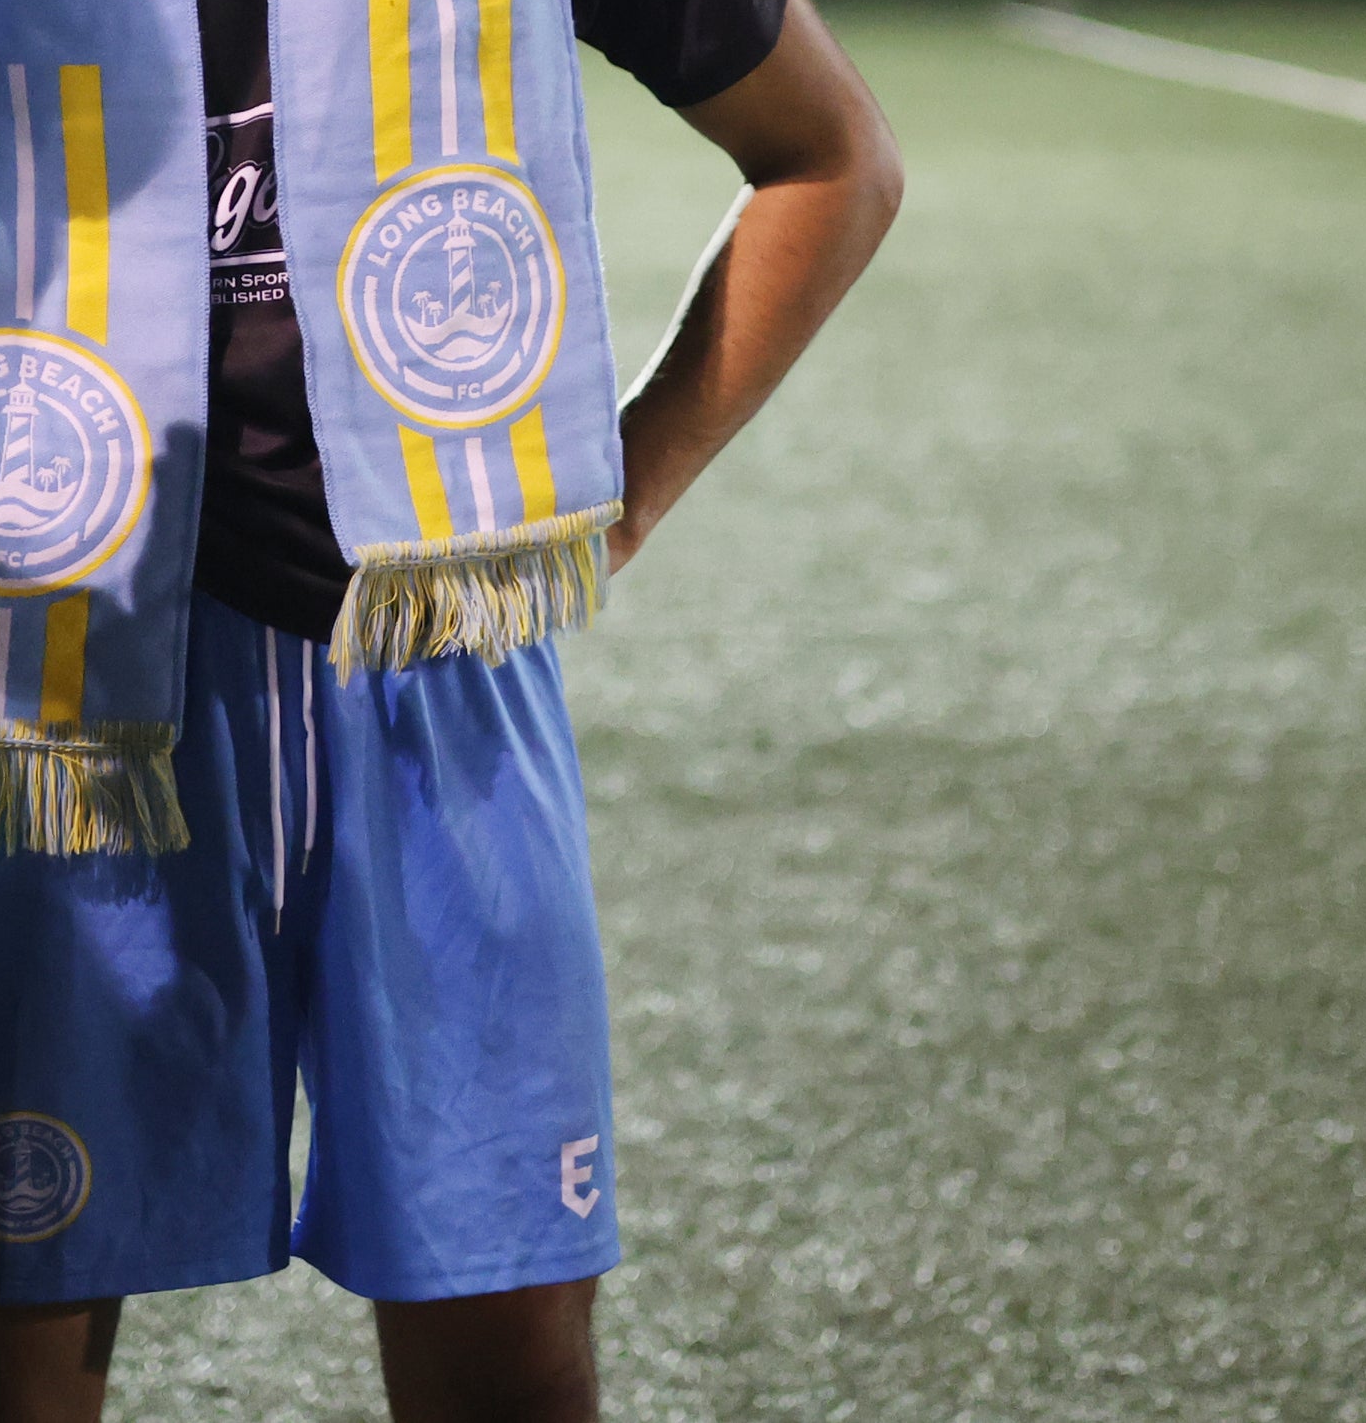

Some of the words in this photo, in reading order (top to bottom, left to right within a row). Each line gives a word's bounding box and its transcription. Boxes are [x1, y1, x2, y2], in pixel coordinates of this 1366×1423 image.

[366, 193, 443, 268] LONG
[452, 188, 536, 252] BEACH
[18, 353, 120, 434] BEACH
[457, 382, 481, 400] FC
